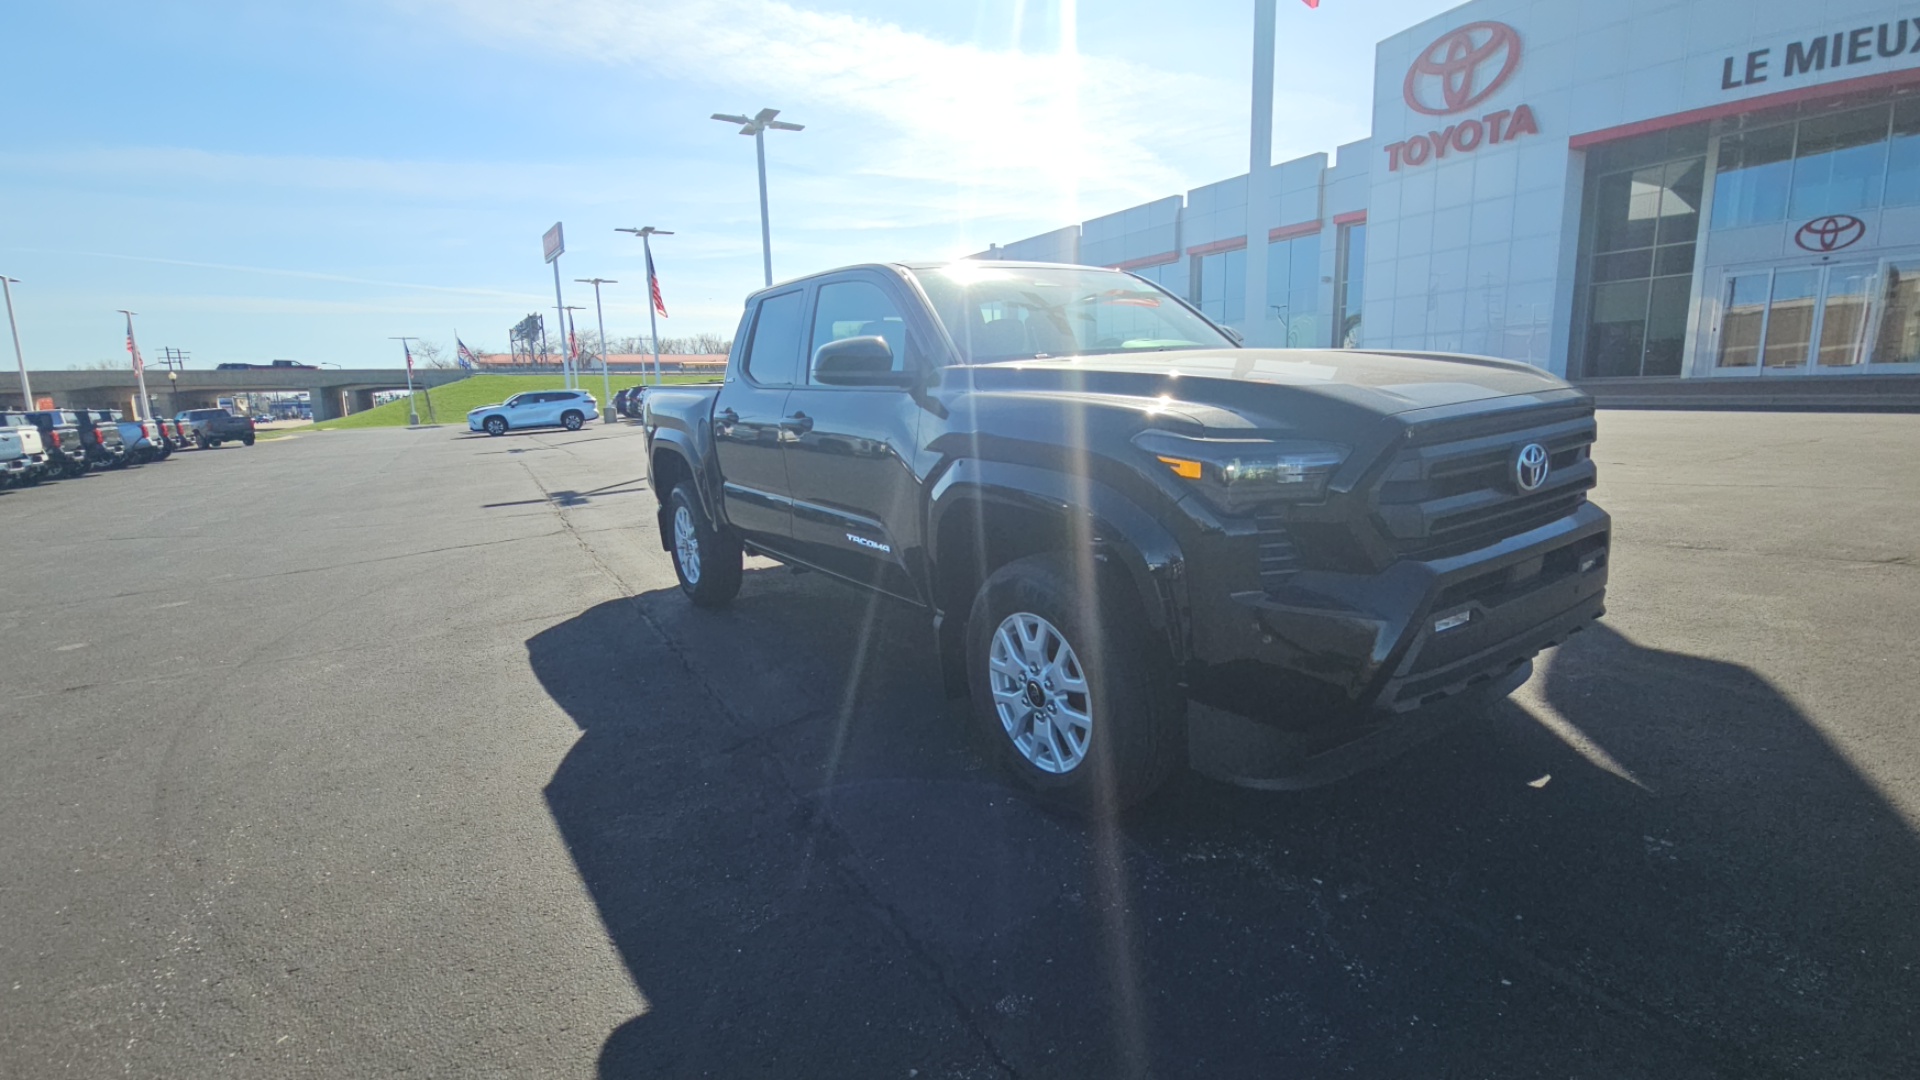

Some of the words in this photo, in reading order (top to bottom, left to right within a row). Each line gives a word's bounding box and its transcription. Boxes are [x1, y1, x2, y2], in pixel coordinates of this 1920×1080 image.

[1721, 48, 1770, 90] LE
[1384, 104, 1539, 172] TOYOTA
[846, 533, 891, 553] TACOMA
